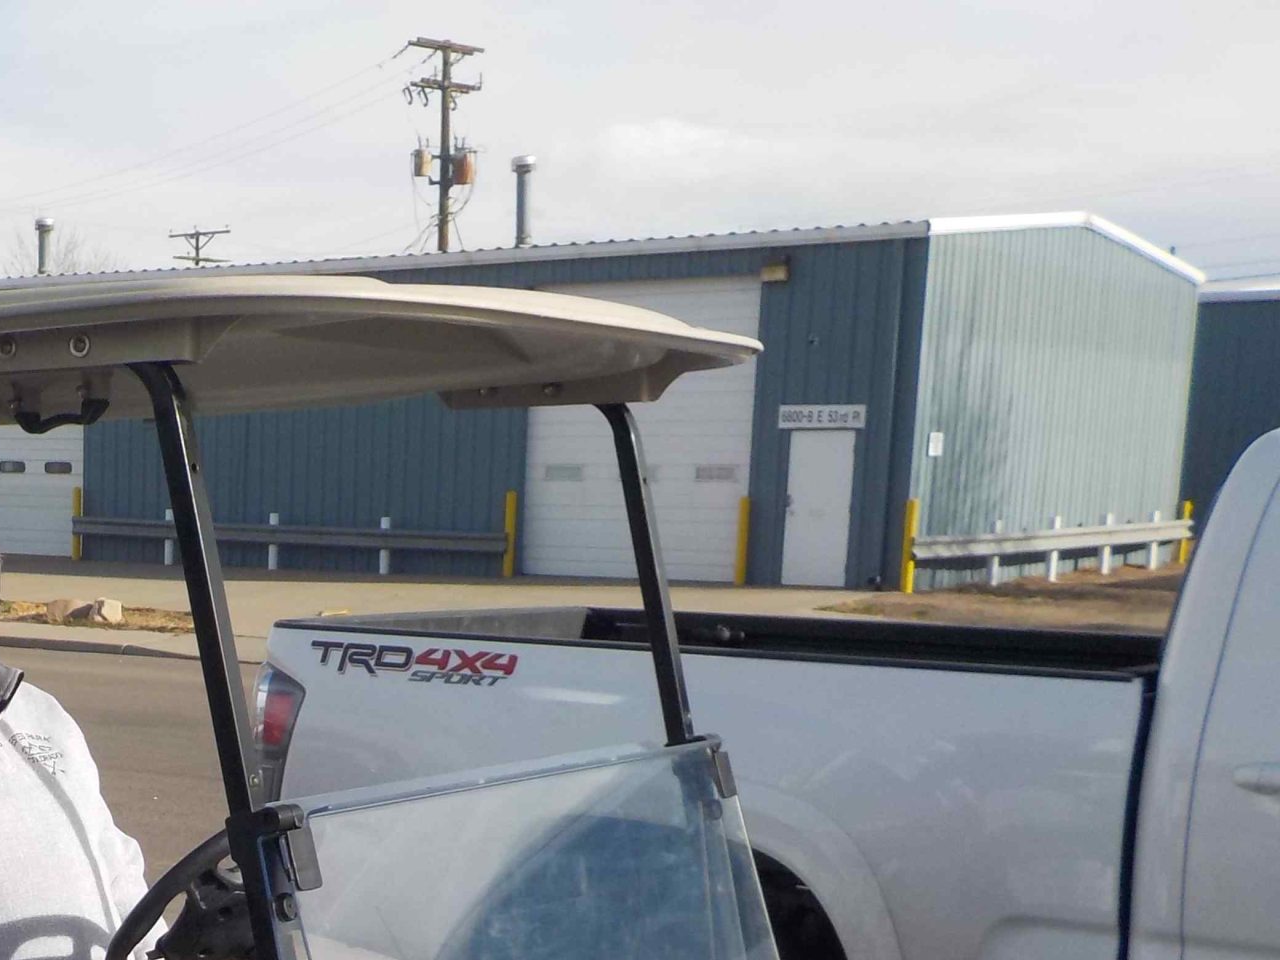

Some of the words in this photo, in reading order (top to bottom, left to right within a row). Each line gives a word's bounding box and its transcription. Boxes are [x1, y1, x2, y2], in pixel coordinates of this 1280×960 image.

[817, 410, 824, 423] E
[311, 640, 415, 677] TRD
[408, 670, 508, 687] SPORT
